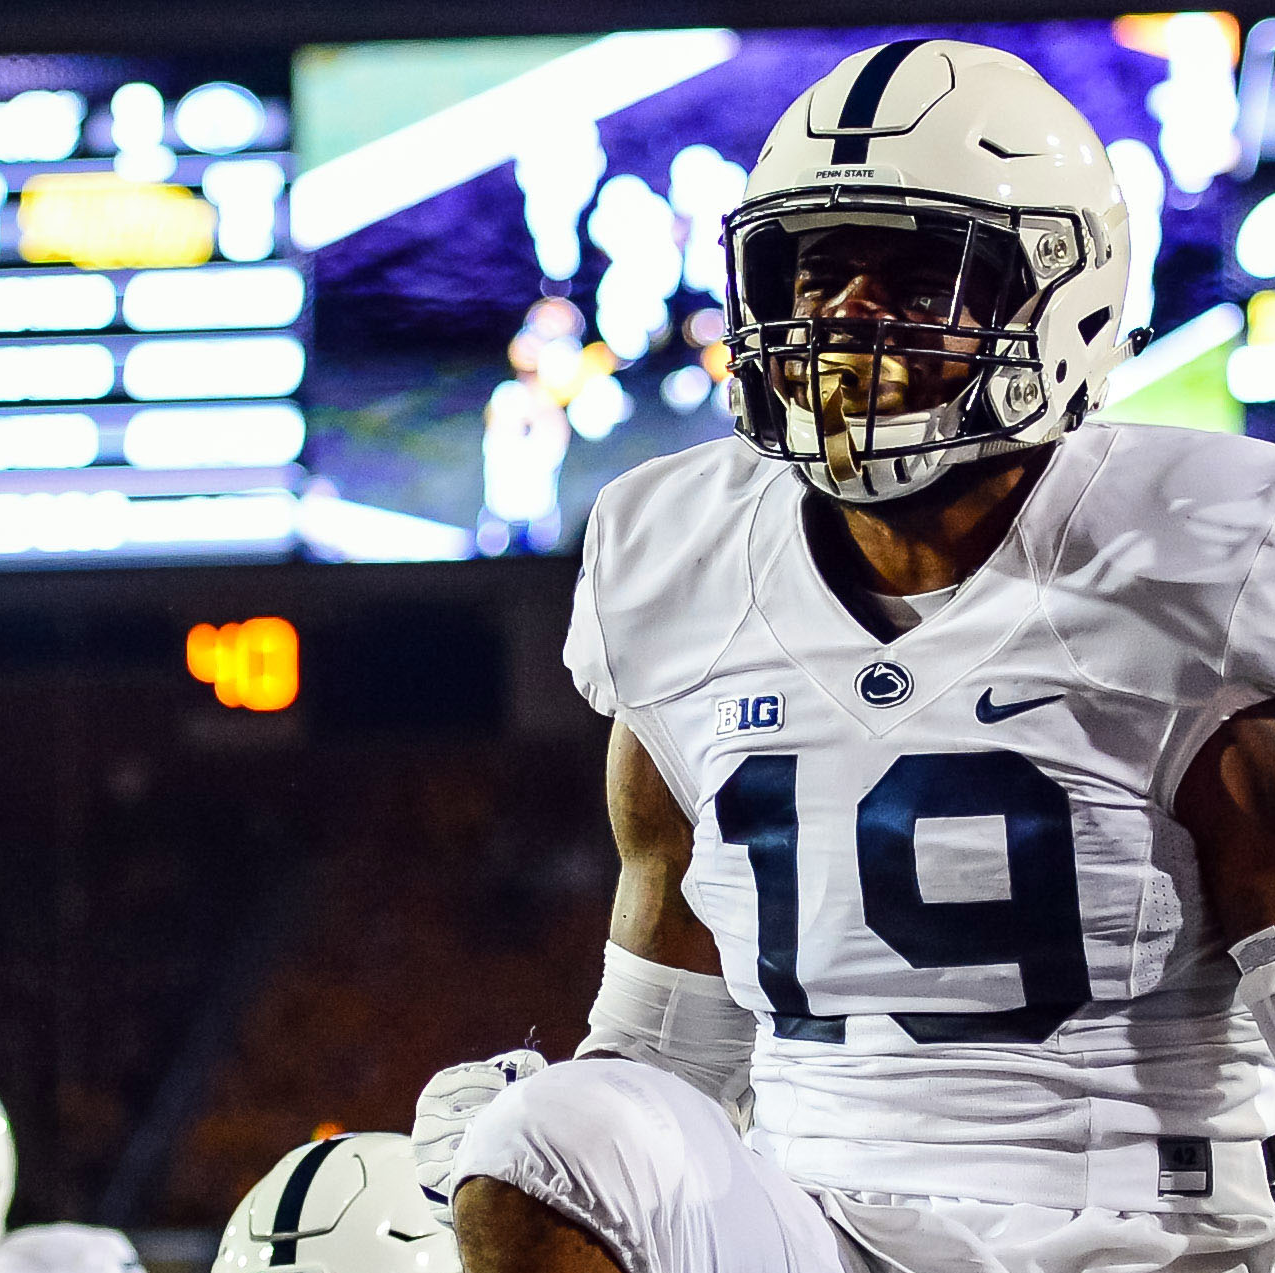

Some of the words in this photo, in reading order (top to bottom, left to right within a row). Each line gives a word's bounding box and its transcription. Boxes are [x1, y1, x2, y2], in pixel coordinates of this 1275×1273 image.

[815, 170, 842, 179] PENN
[844, 169, 875, 178] STATE
[714, 750, 1093, 1046] 19
